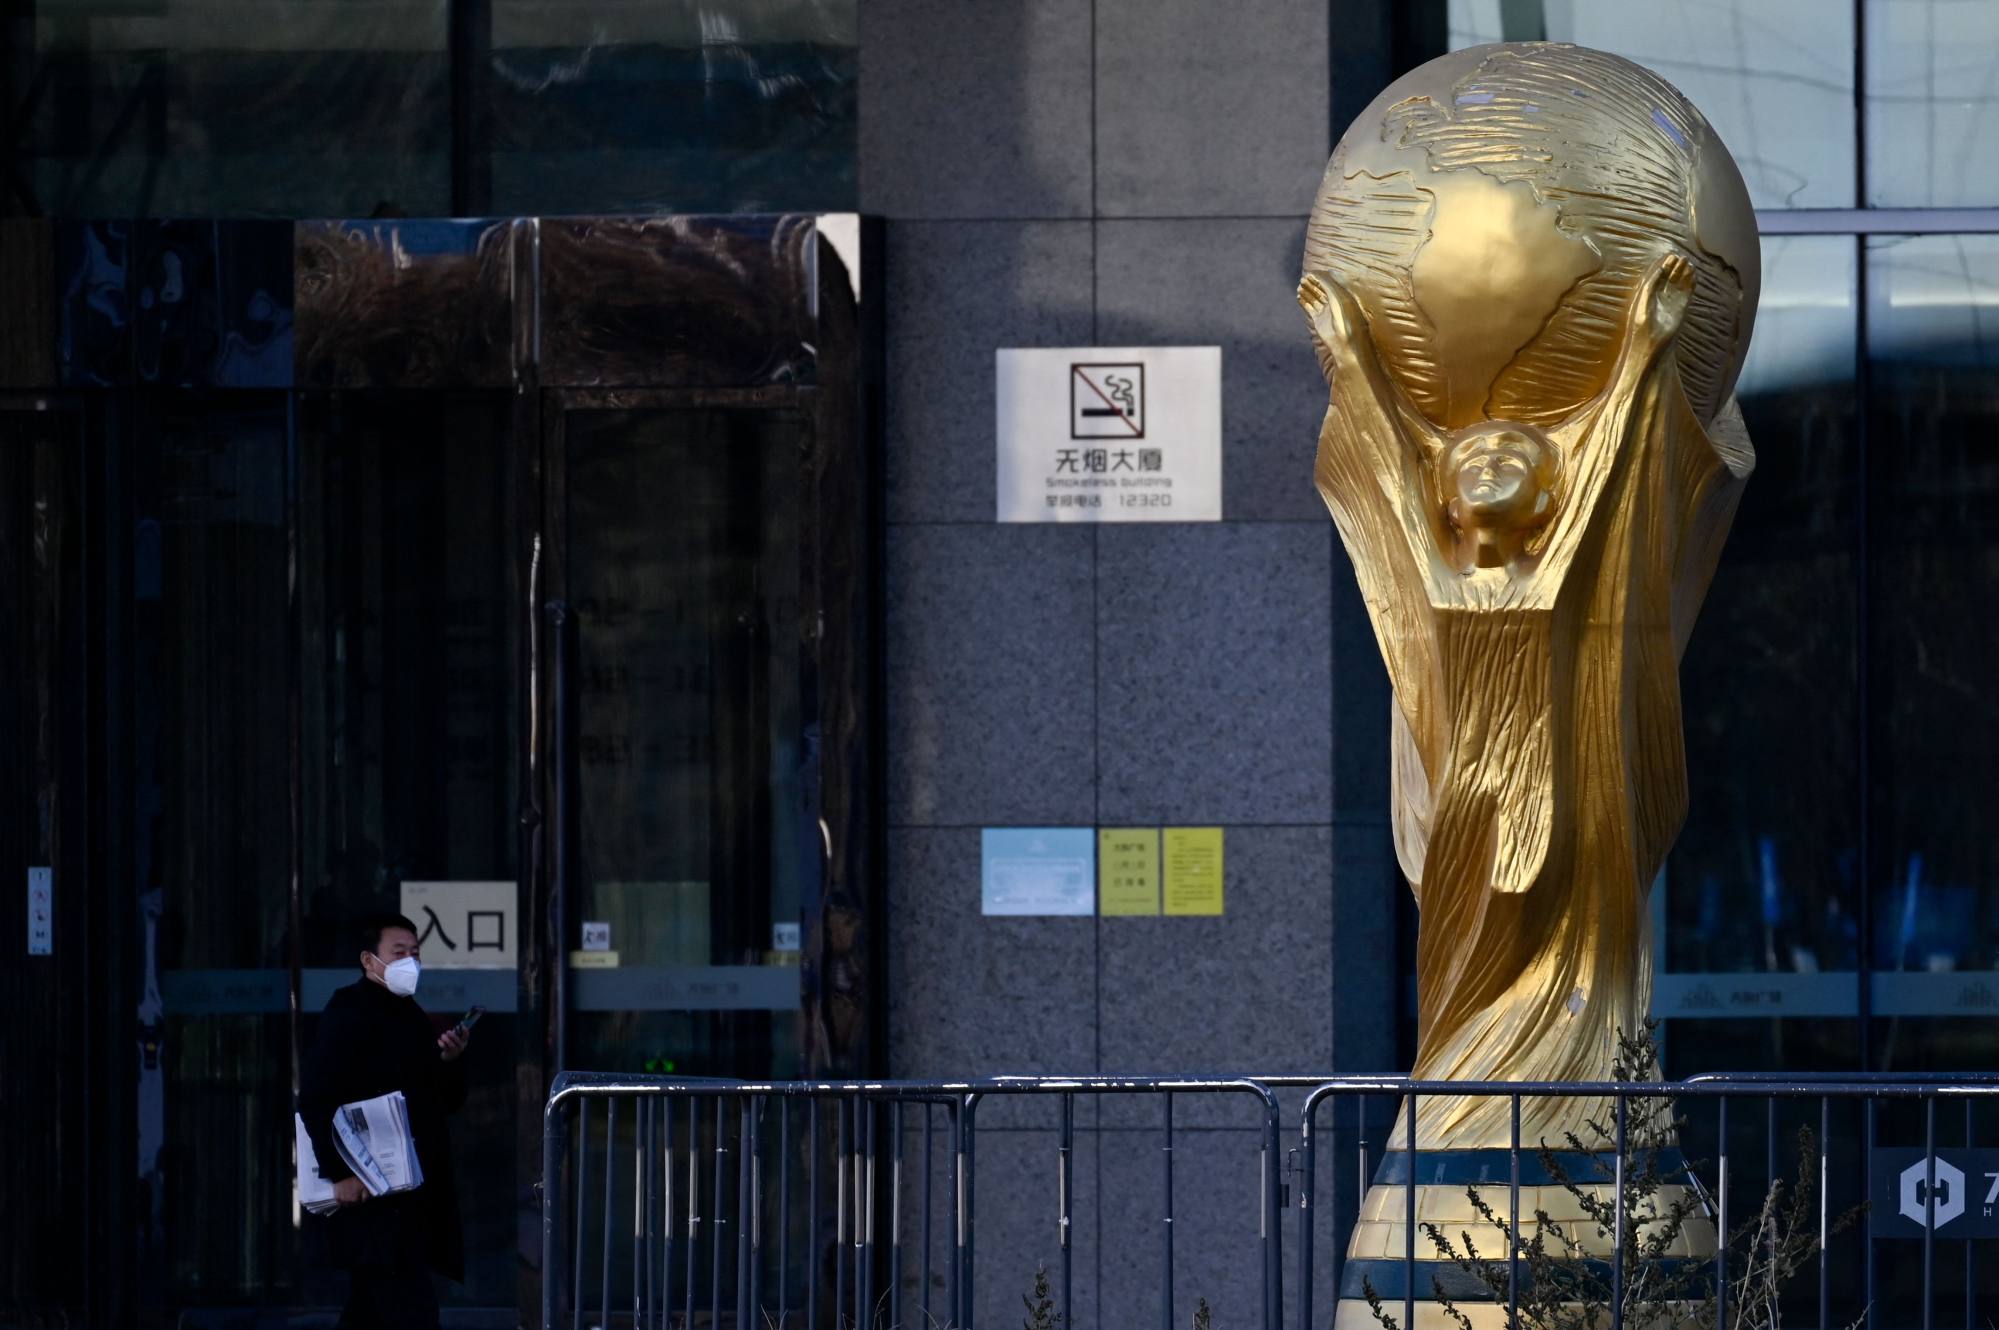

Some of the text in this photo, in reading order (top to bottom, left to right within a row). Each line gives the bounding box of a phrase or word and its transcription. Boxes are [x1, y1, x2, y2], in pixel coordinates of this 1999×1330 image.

[1056, 449, 1162, 473] 无烟大厦
[1120, 494, 1172, 507] 12320
[418, 904, 504, 952] 入口
